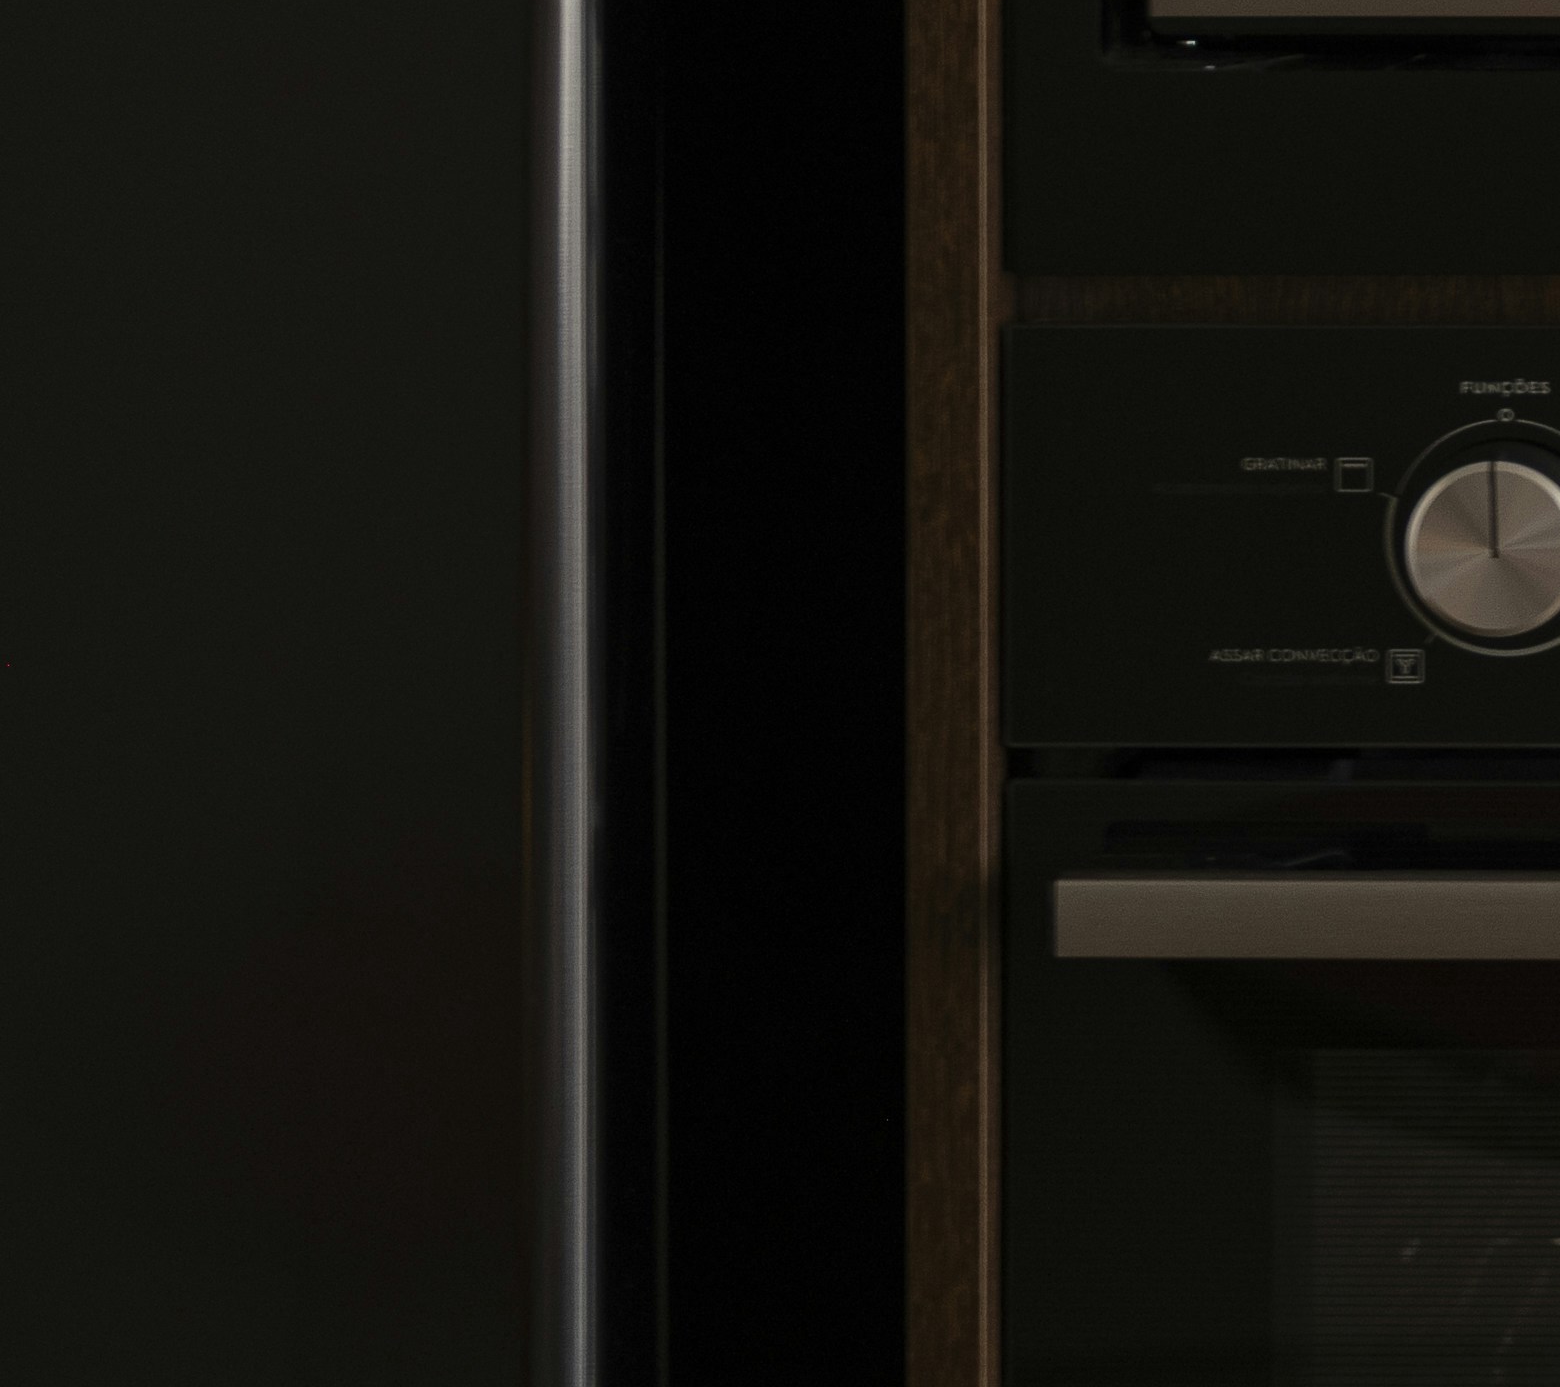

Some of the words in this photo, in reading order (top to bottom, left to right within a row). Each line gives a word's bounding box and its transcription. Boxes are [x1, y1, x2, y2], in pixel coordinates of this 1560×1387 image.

[1459, 377, 1552, 397] FUNÇÕES
[1240, 456, 1327, 472] GRATINAR
[1209, 648, 1265, 663] ASSAR
[1266, 646, 1380, 665] CONVECÇÃO
